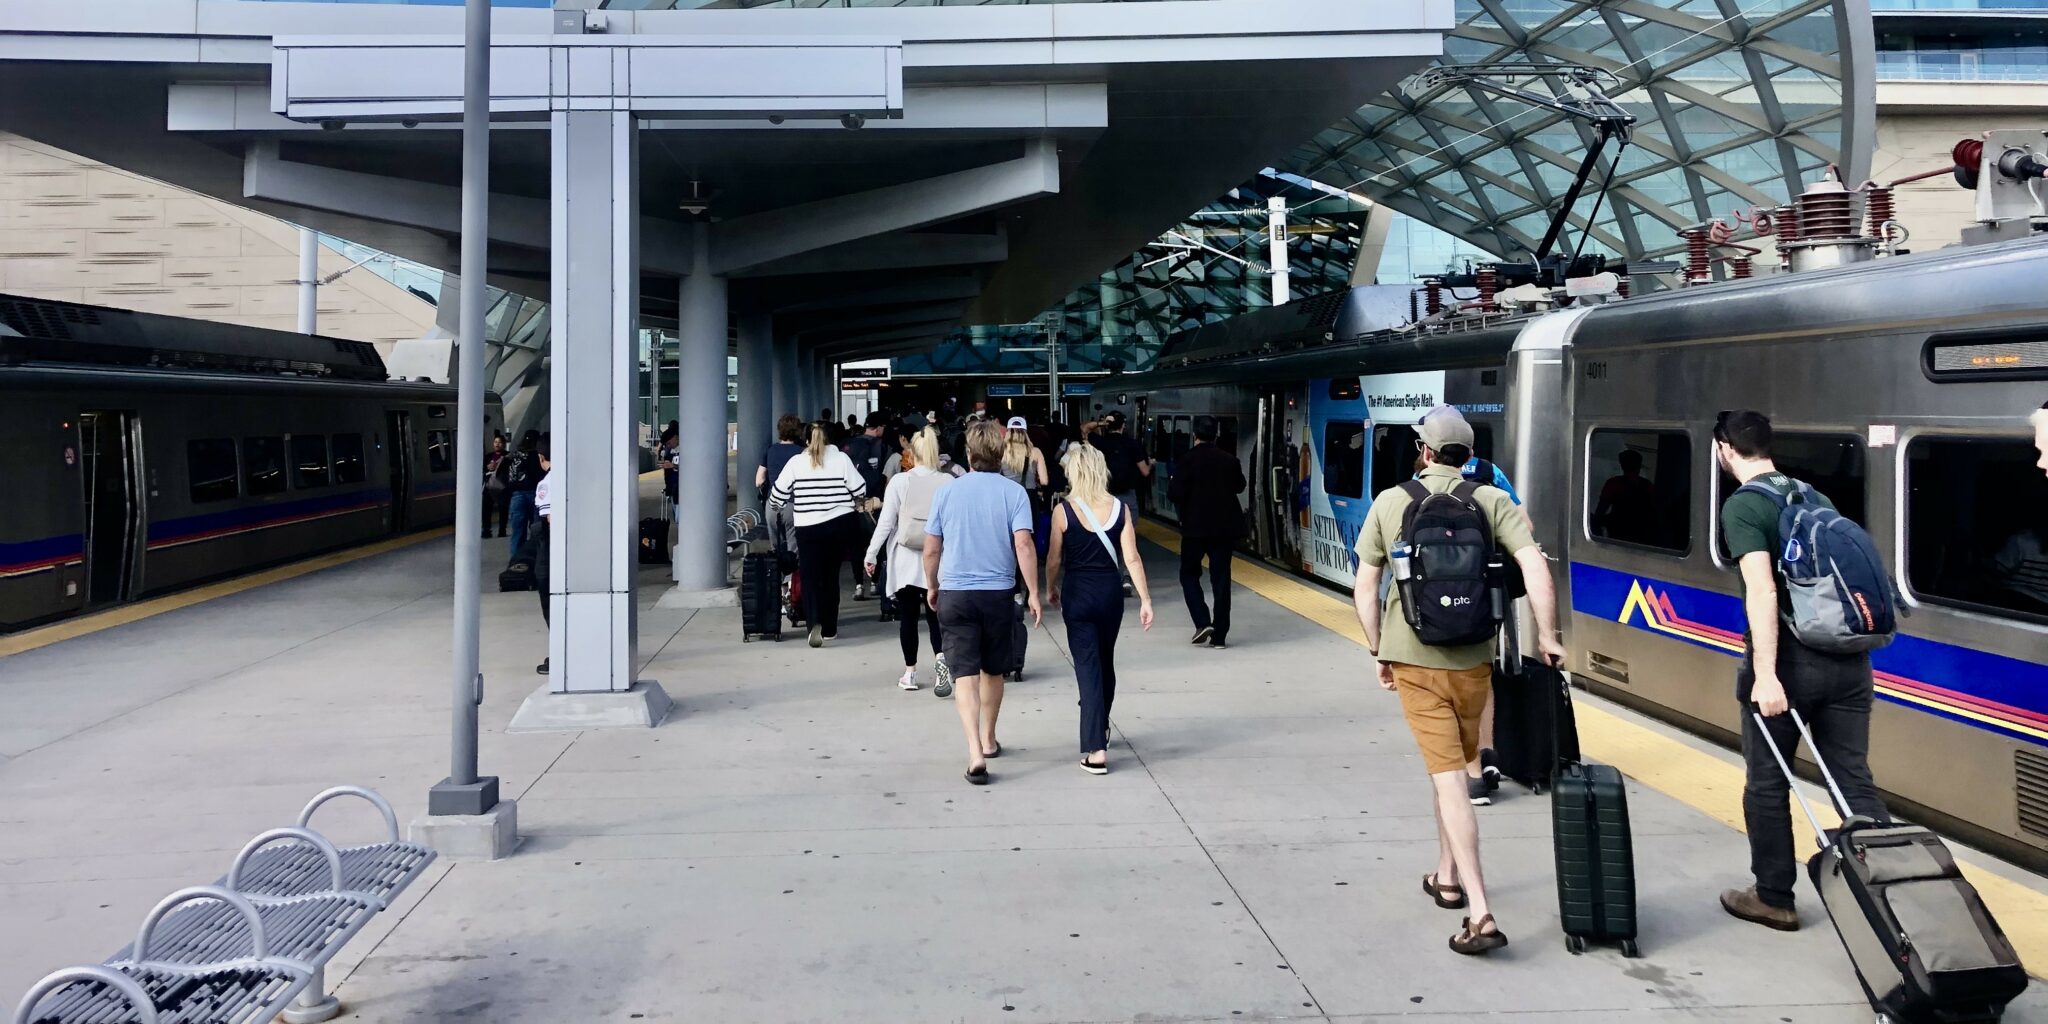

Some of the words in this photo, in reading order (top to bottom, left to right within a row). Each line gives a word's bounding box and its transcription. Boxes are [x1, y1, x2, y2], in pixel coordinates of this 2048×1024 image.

[1586, 361, 1607, 379] 4011
[1368, 394, 1377, 408] The
[1383, 394, 1405, 408] American
[1405, 393, 1420, 411] Single
[1421, 393, 1435, 408] Malt.
[1313, 514, 1348, 546] SETTING
[1314, 540, 1332, 568] FOR
[1333, 545, 1350, 573] TOP
[1453, 595, 1471, 607] ptc
[1854, 592, 1875, 631] patagonia
